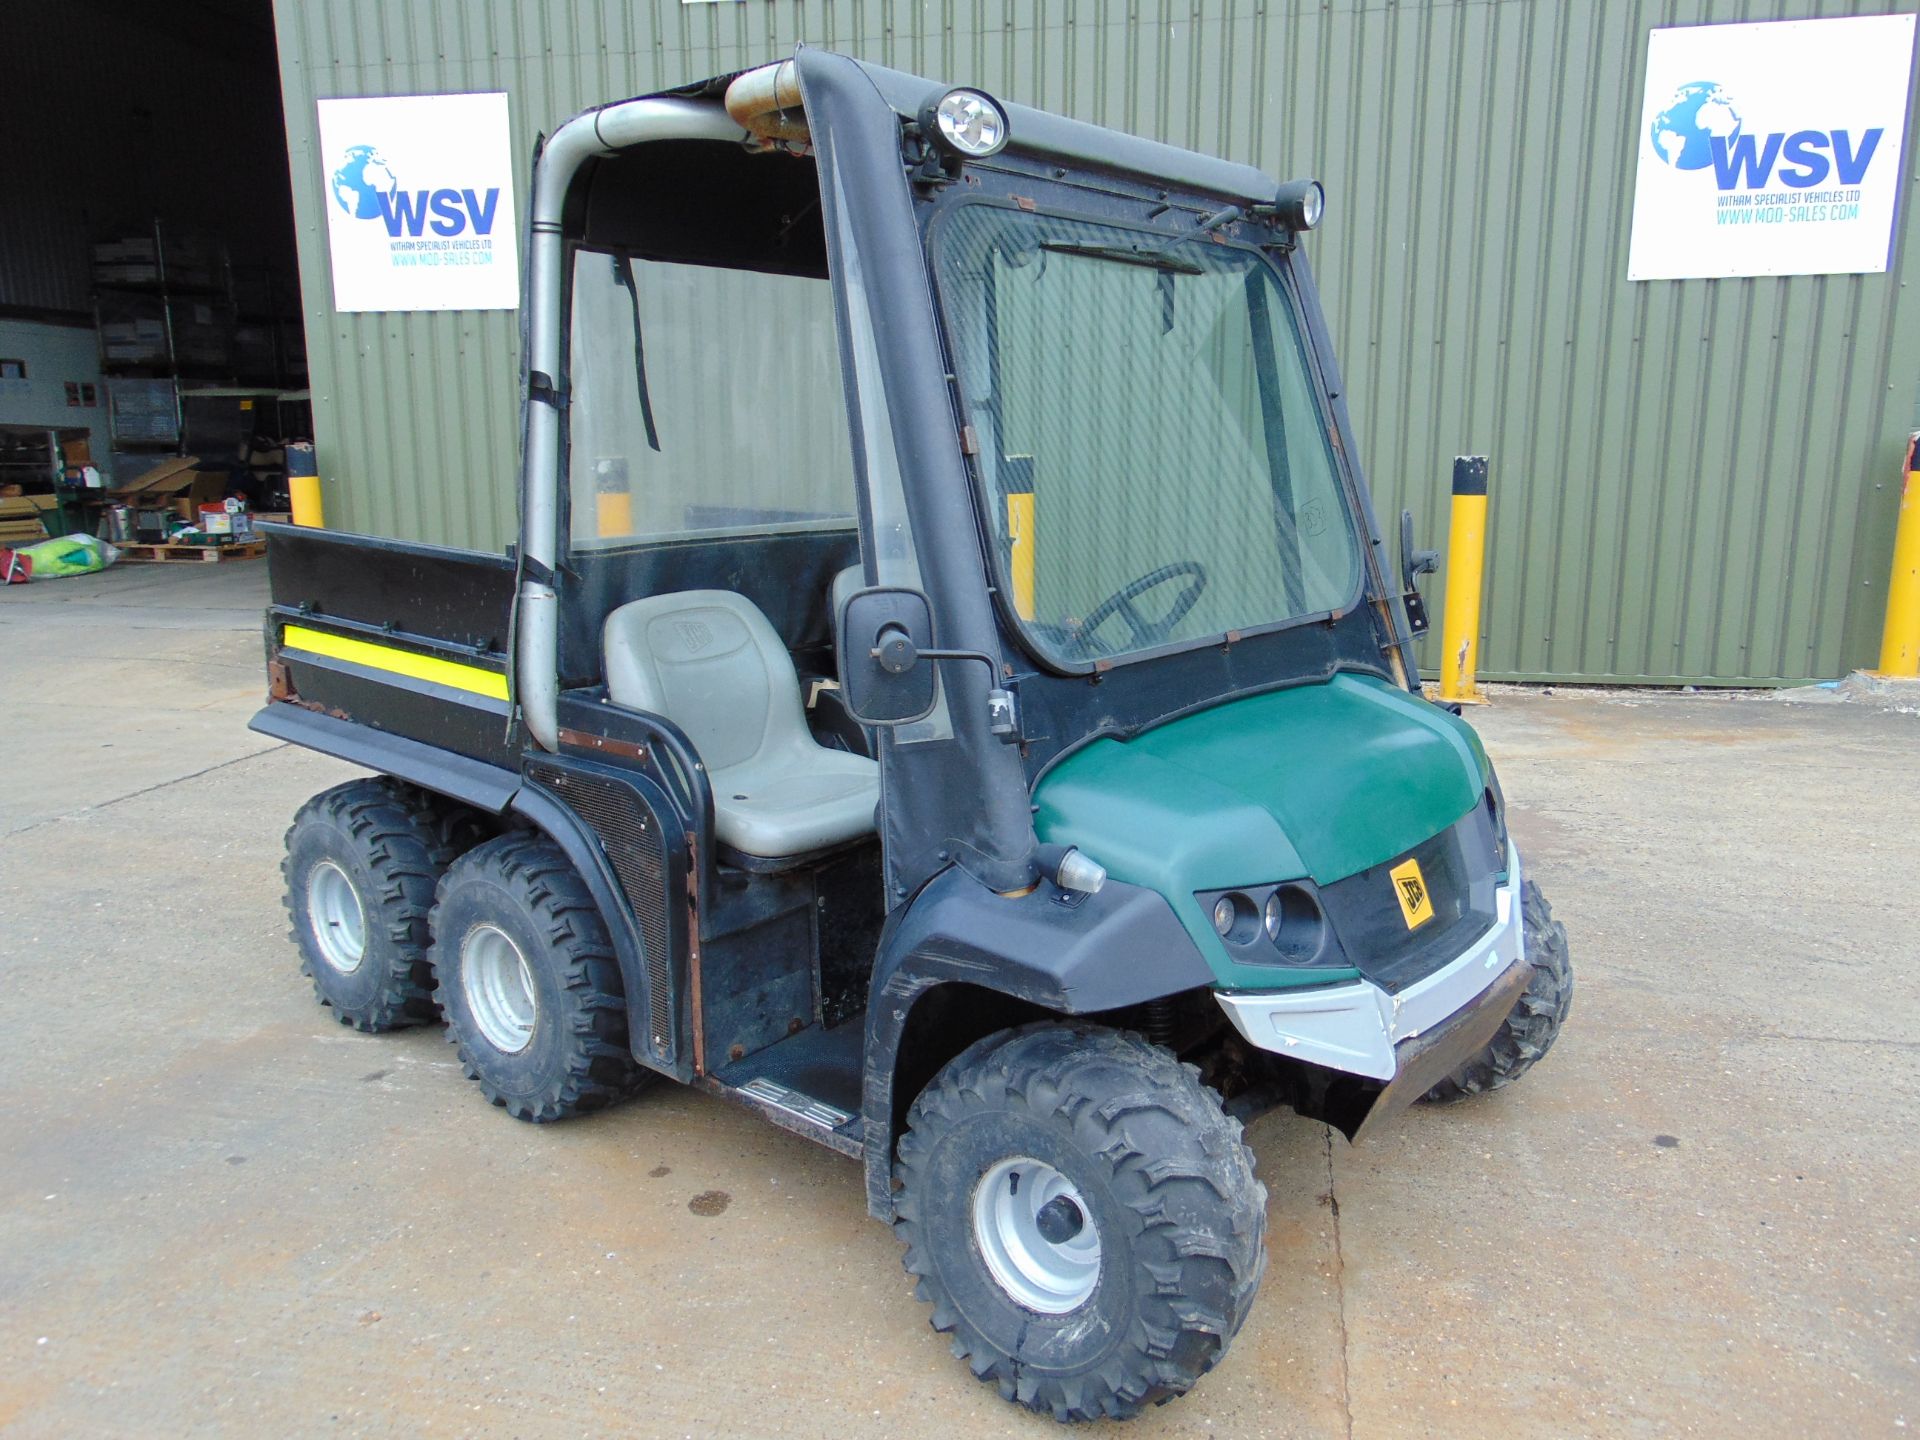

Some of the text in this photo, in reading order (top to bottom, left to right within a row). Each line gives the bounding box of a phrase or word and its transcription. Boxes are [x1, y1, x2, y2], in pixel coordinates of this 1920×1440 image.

[1710, 128, 1885, 190] WSV
[1717, 190, 1861, 207] WITHAM SPECIALIST VEHICLES LTD
[376, 188, 500, 237] WSV
[1717, 203, 1859, 225] WWWMOD-SALESCOM
[390, 239, 492, 251] WITHAM SPECIALIST VEHICLES LTD
[391, 251, 493, 266] WWWMOD-SALESCOM
[1401, 880, 1423, 909] JCB
